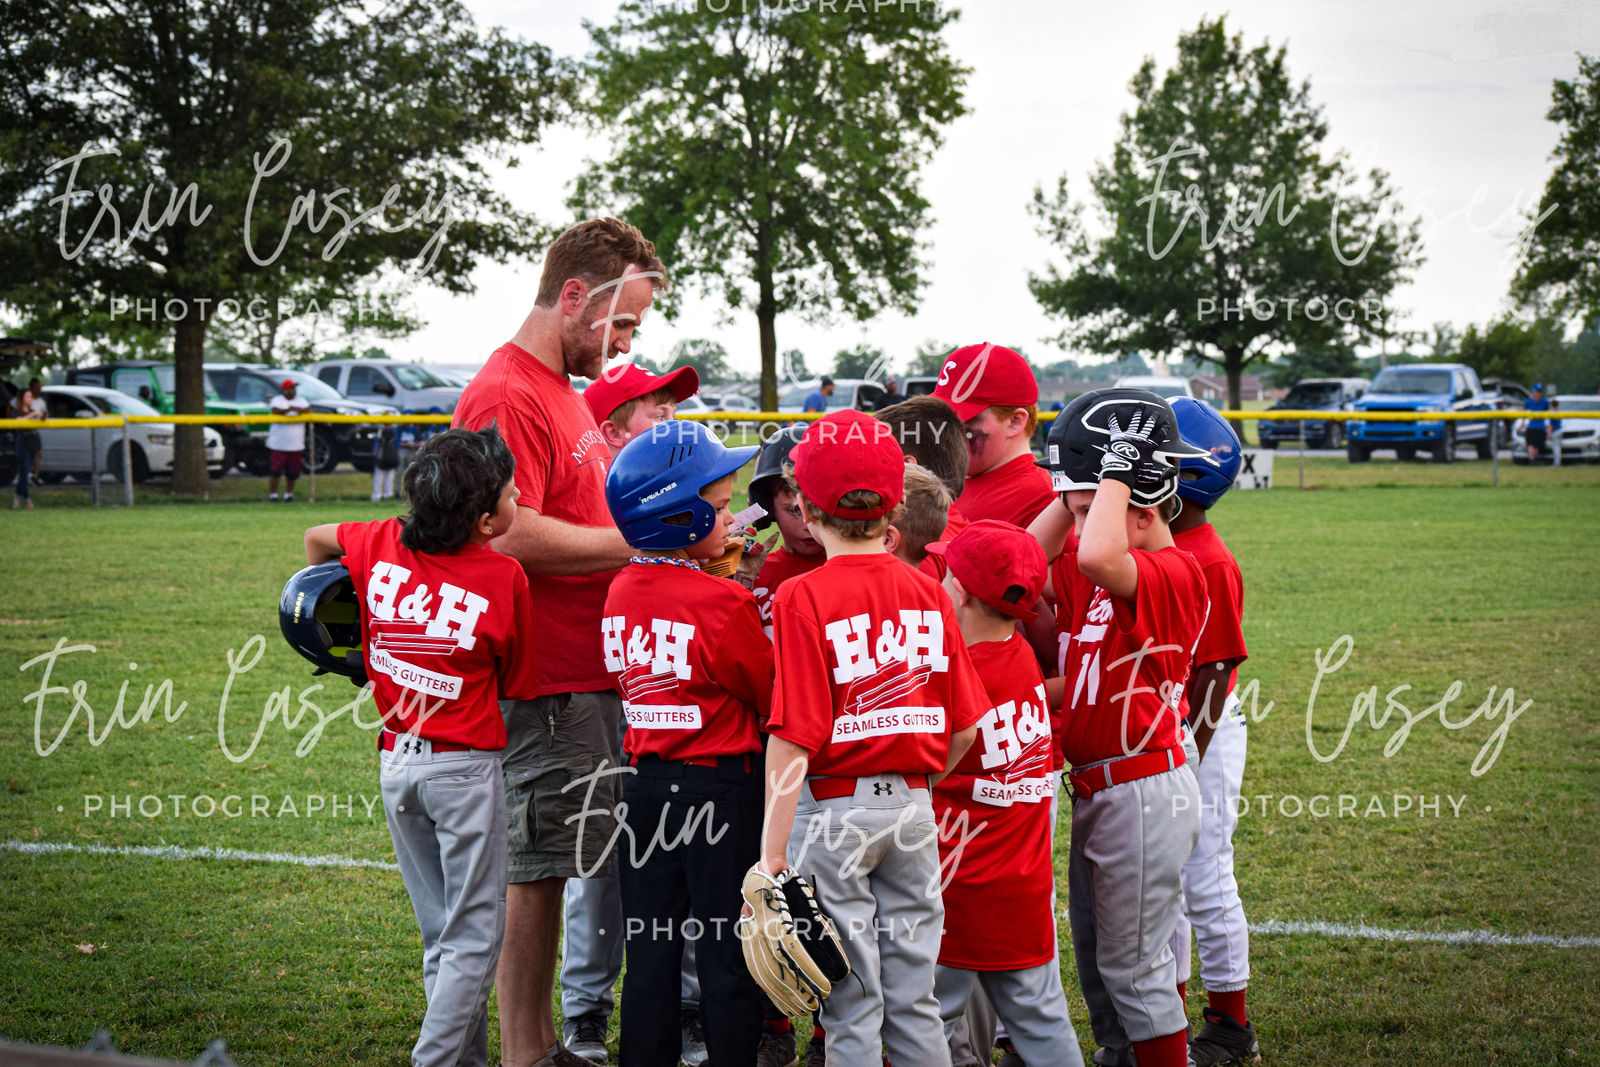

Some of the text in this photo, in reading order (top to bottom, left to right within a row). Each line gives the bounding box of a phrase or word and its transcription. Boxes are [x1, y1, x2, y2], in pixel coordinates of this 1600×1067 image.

[938, 361, 957, 387] S
[367, 560, 489, 651] H&H
[601, 616, 695, 680] H&H
[825, 609, 949, 685] H&H
[400, 669, 455, 693] GUTTERS
[837, 714, 899, 735] SEAMLESS
